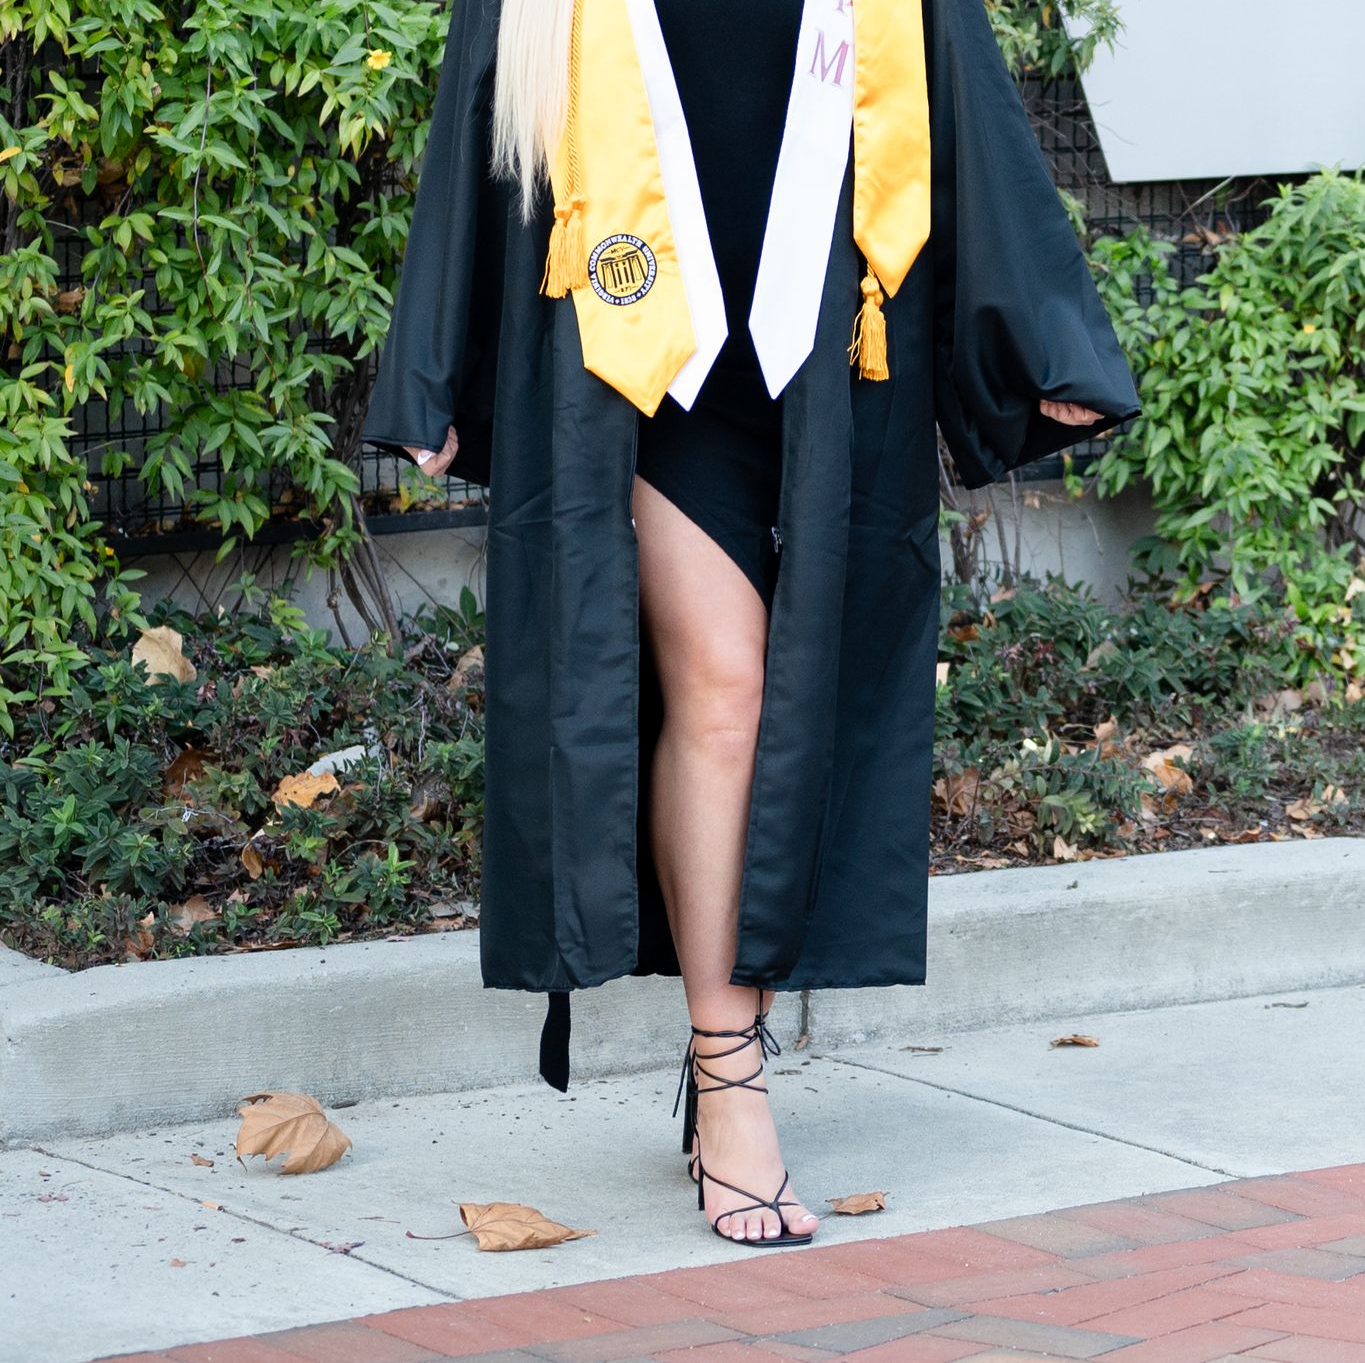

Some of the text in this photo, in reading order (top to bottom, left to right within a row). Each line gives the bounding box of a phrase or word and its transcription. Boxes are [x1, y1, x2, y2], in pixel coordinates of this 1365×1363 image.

[589, 235, 656, 304] VIRGINIA COMMONWEALTH UNIVERSITY
